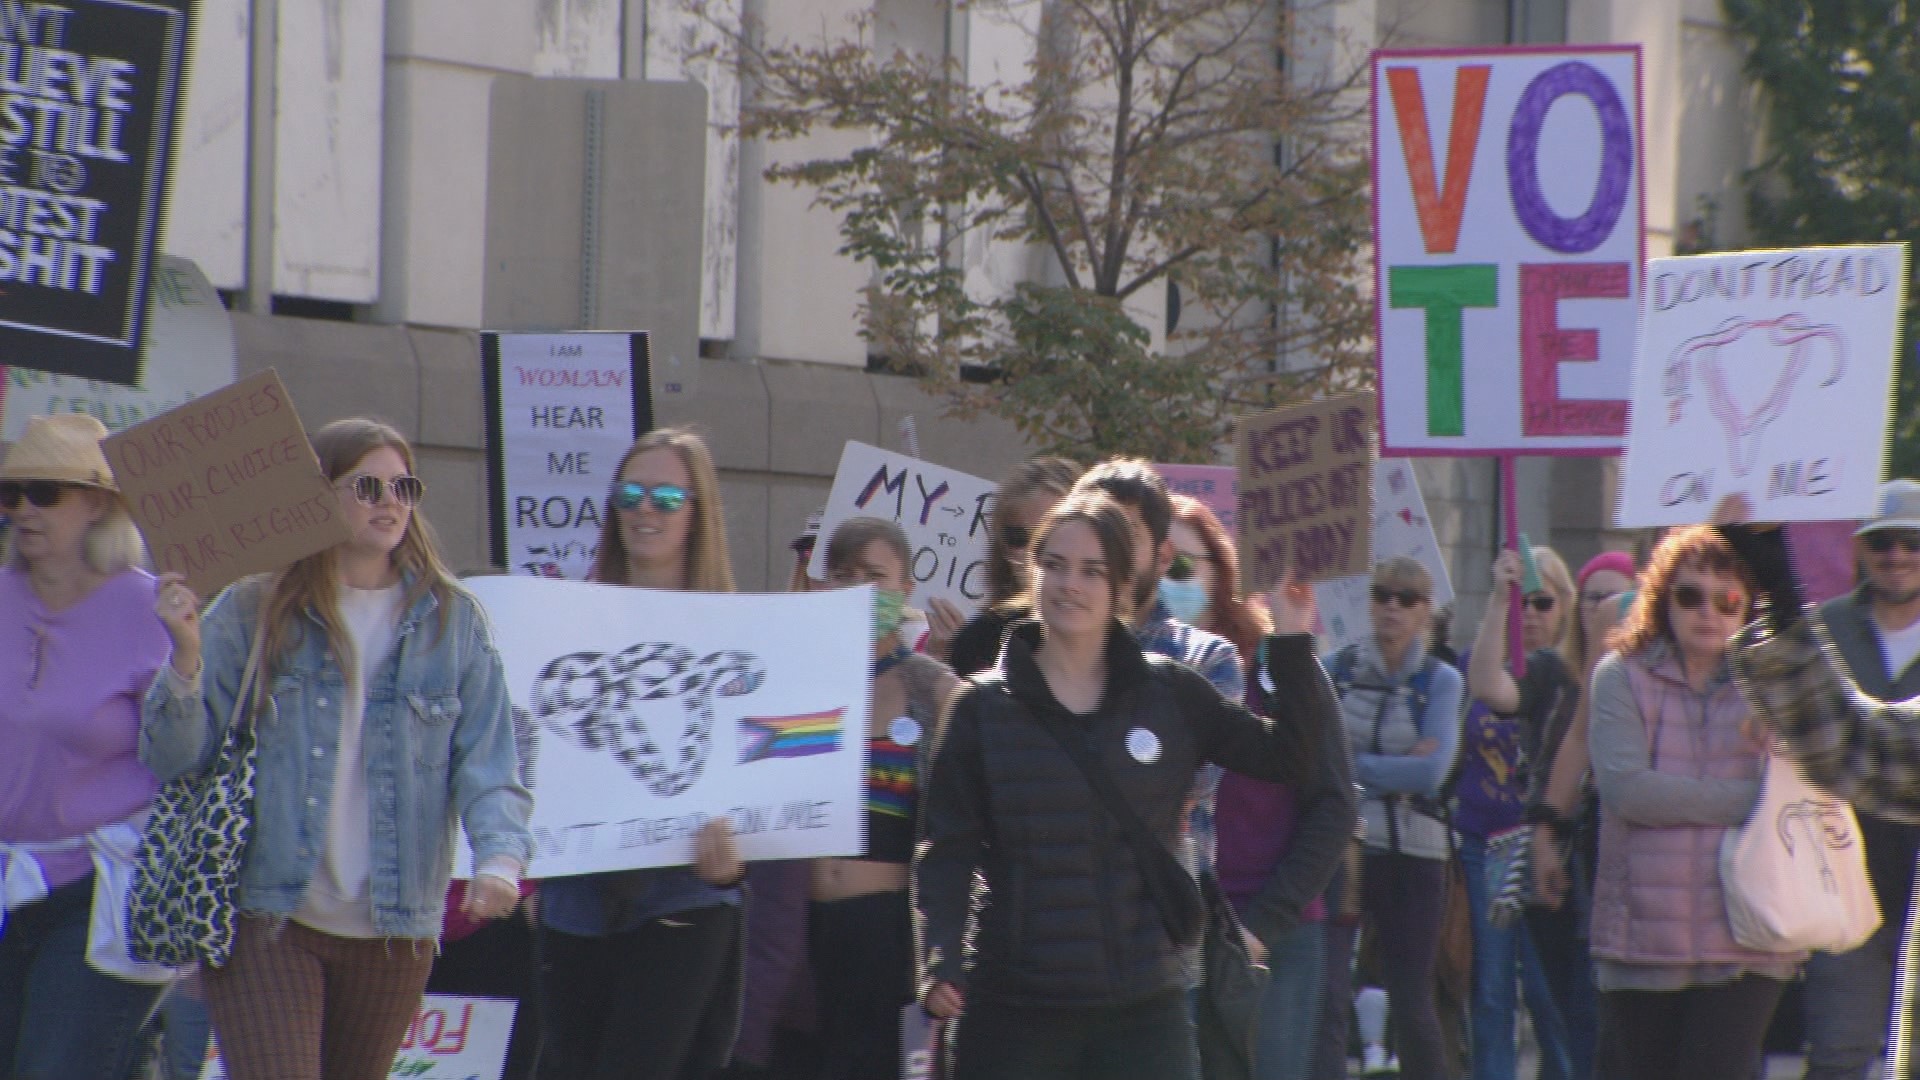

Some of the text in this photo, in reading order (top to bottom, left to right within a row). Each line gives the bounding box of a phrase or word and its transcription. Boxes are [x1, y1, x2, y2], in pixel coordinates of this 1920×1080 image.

[0, 42, 136, 113] LIEVE
[0, 92, 131, 163] STILL
[1768, 255, 1890, 299] TREAD
[515, 366, 627, 387] WOMAN
[557, 345, 583, 357] AM
[120, 384, 280, 478] OUR BODIES
[531, 406, 604, 428] HEAR
[1248, 406, 1367, 478] KEEP UR
[140, 435, 299, 529] OUR CHOICE
[548, 452, 591, 474] ME
[1658, 467, 1716, 507] ON
[515, 496, 603, 528] ROA
[855, 463, 949, 525] MY
[165, 492, 332, 577] OUR RIGHTS
[937, 532, 957, 547] TO
[1293, 518, 1356, 581] BODY
[912, 546, 986, 599] OIC
[530, 822, 608, 860] NT
[772, 798, 834, 832] ME
